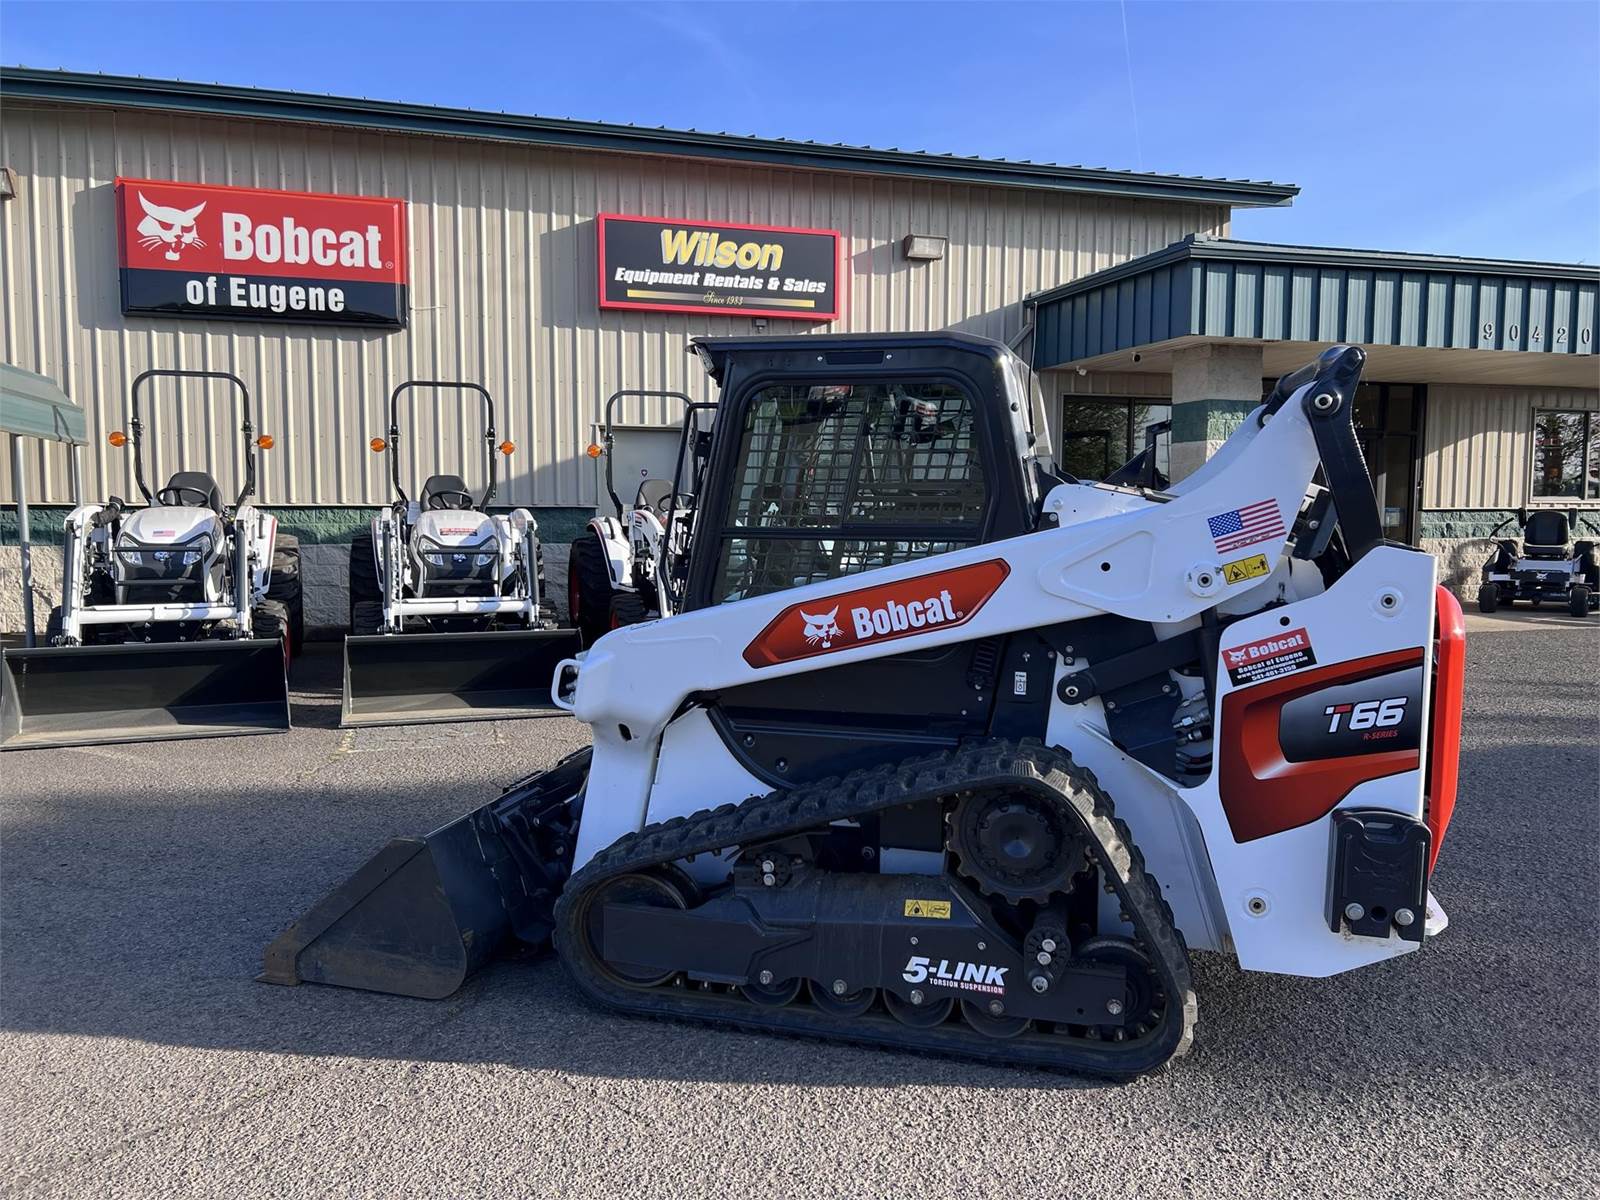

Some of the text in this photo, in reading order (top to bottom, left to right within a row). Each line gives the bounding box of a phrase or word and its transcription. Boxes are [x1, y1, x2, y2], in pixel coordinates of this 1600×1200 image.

[222, 212, 382, 269] Bobcat
[661, 229, 784, 272] Wilson
[186, 276, 345, 313] of Eugene
[615, 267, 827, 293] Equipment Rentals & Sales
[703, 290, 725, 304] Since
[851, 590, 956, 640] Bobcat
[1248, 634, 1304, 658] Bobcat
[1238, 651, 1304, 674] Bobcat of Eugene
[1325, 697, 1408, 733] T66
[902, 956, 1009, 986] 5-LINK
[929, 977, 1003, 994] TORSION SUSPENSION
